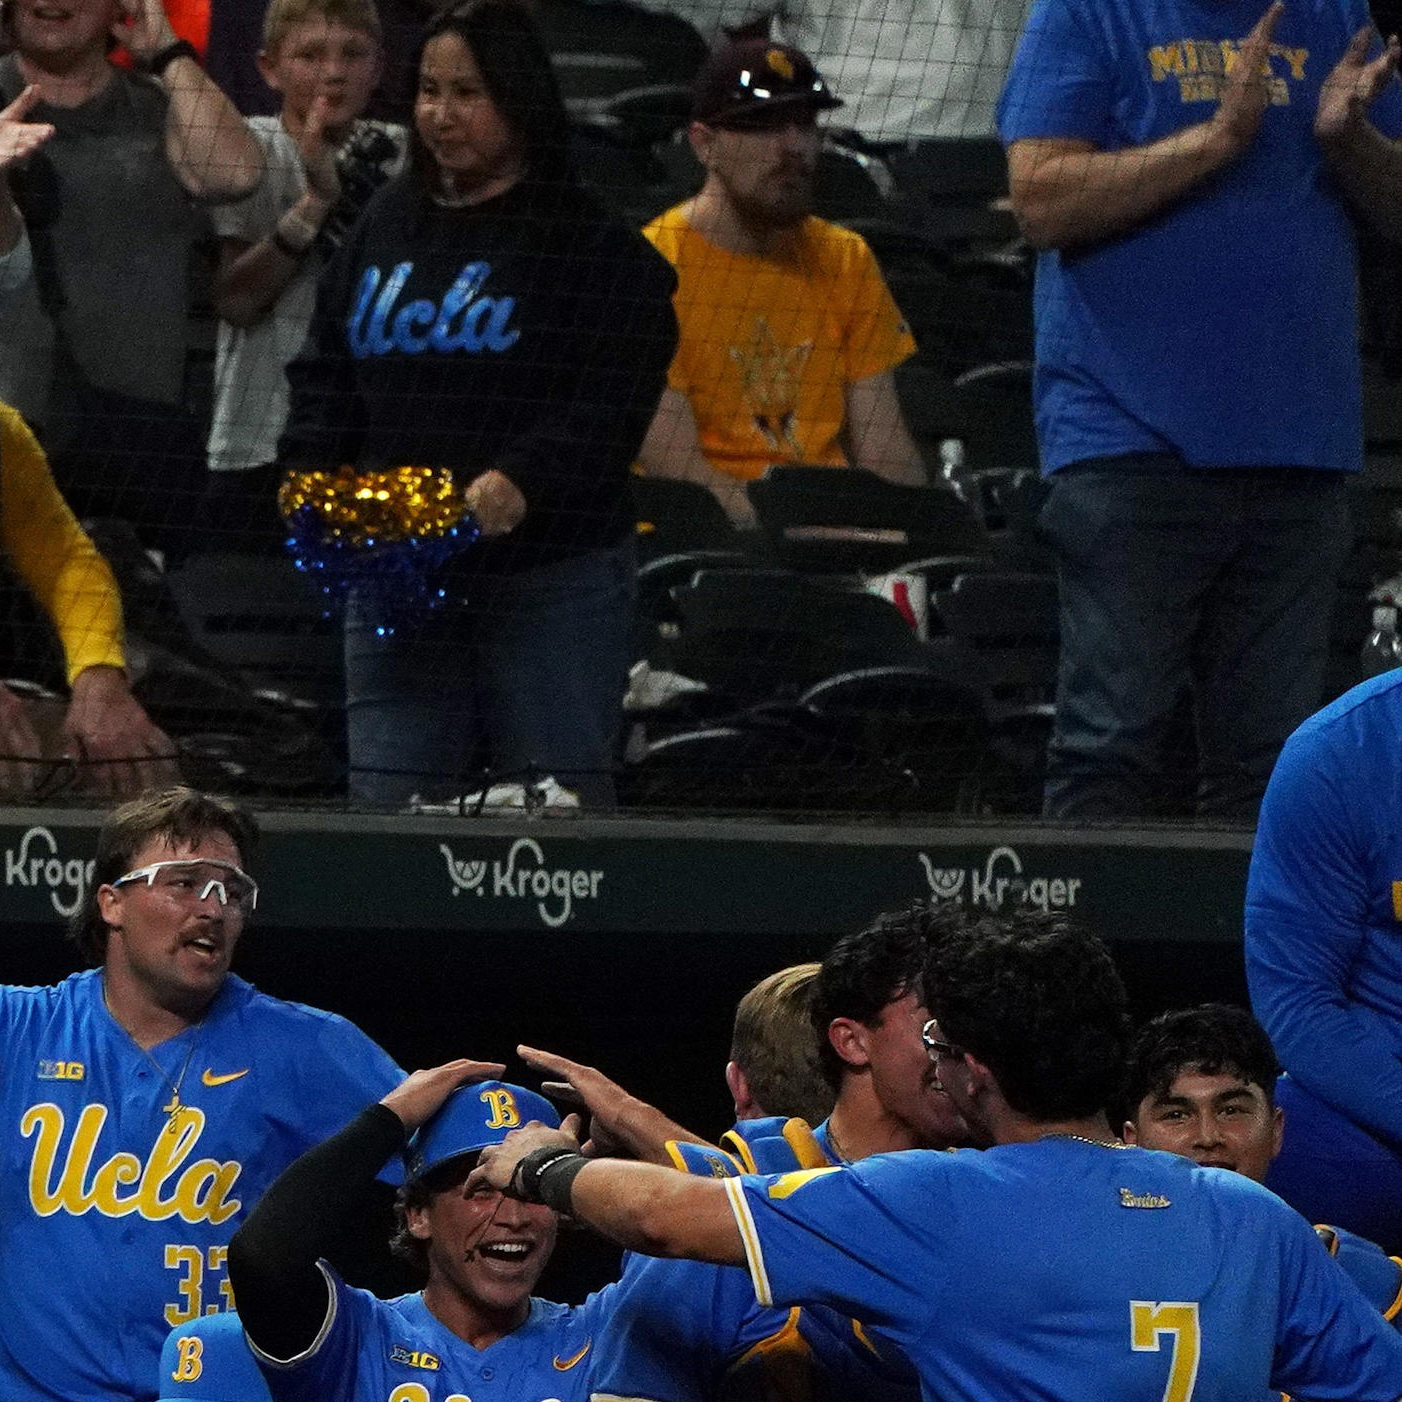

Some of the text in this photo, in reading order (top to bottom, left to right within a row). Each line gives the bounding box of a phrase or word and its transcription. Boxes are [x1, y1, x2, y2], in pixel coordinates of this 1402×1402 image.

[347, 261, 521, 358] Ucla
[5, 826, 96, 917] Krog
[494, 838, 603, 926] Kroger
[972, 847, 1082, 914] Krger
[480, 1088, 522, 1129] B
[20, 1101, 242, 1225] Ucla
[172, 1336, 203, 1383] B
